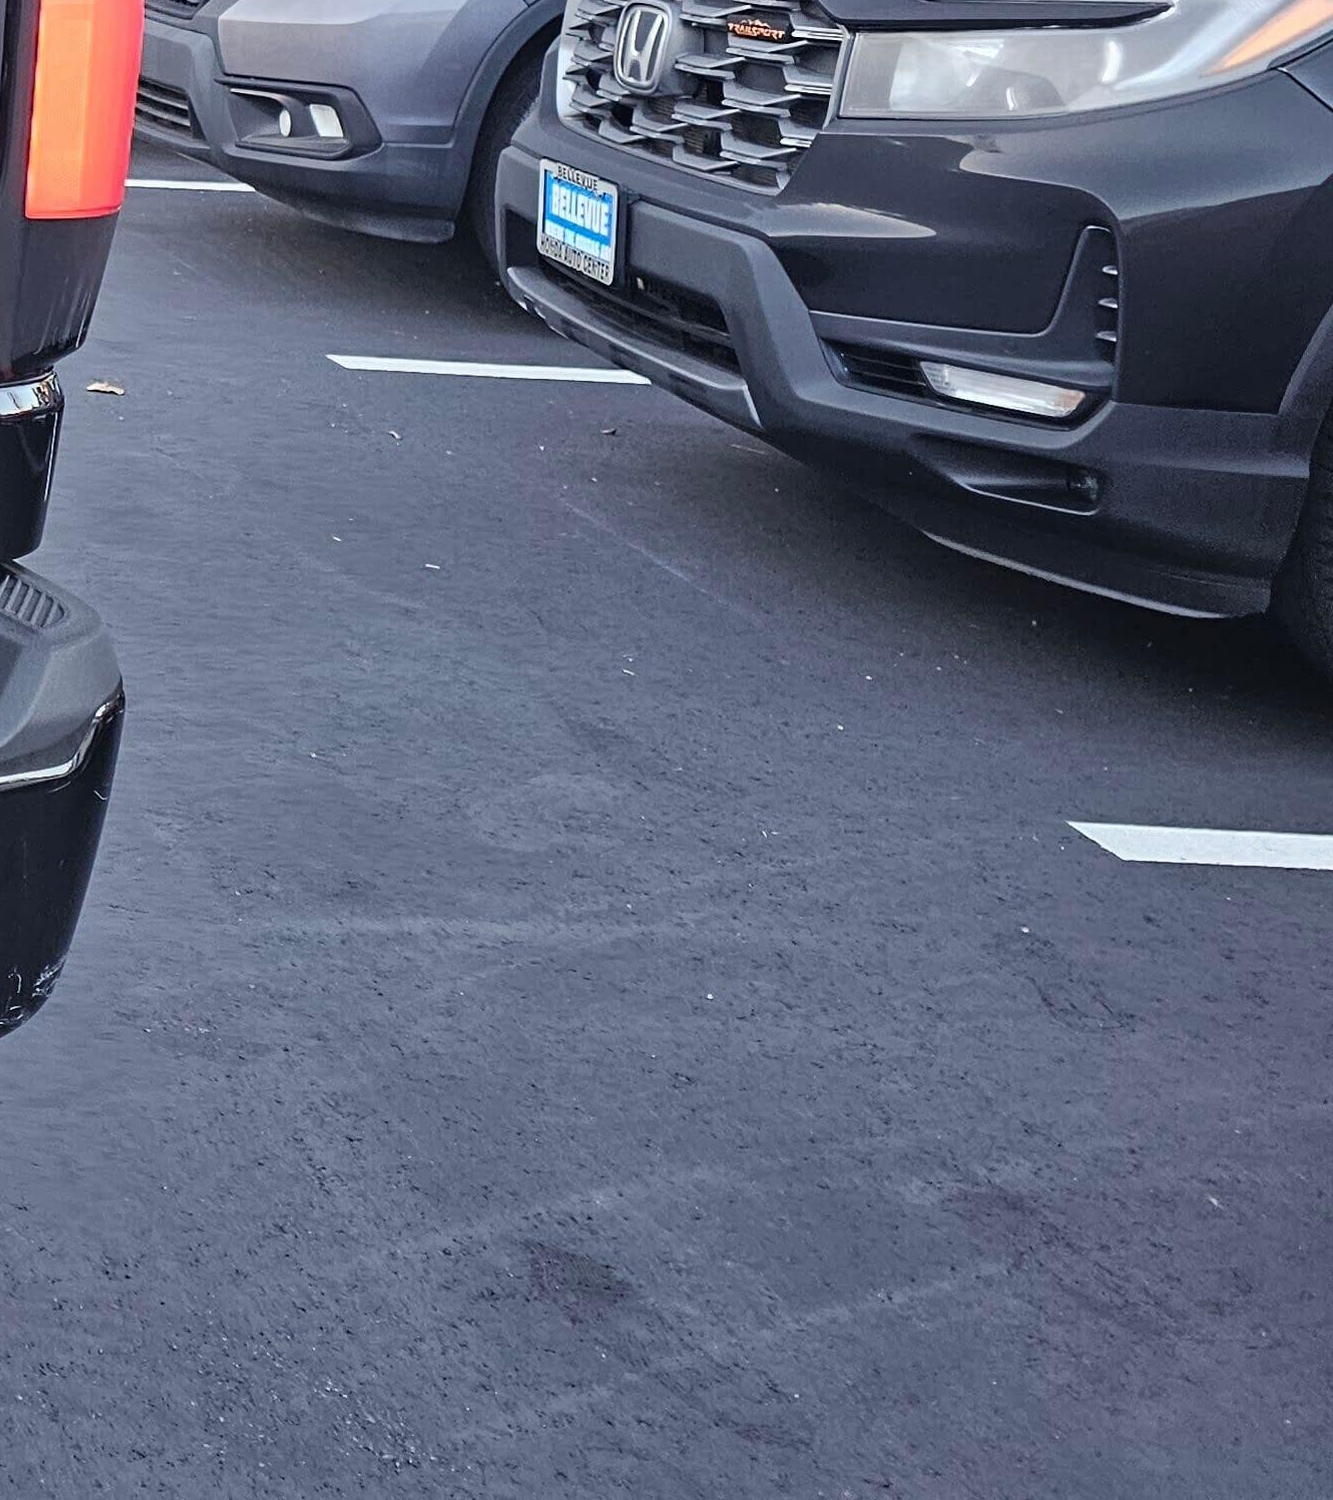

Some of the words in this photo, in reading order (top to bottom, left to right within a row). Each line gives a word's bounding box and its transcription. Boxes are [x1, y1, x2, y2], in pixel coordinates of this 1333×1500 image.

[728, 23, 785, 39] TRAILSPORT
[558, 166, 598, 190] BELLEVUE
[551, 183, 610, 237] BELLEVUE
